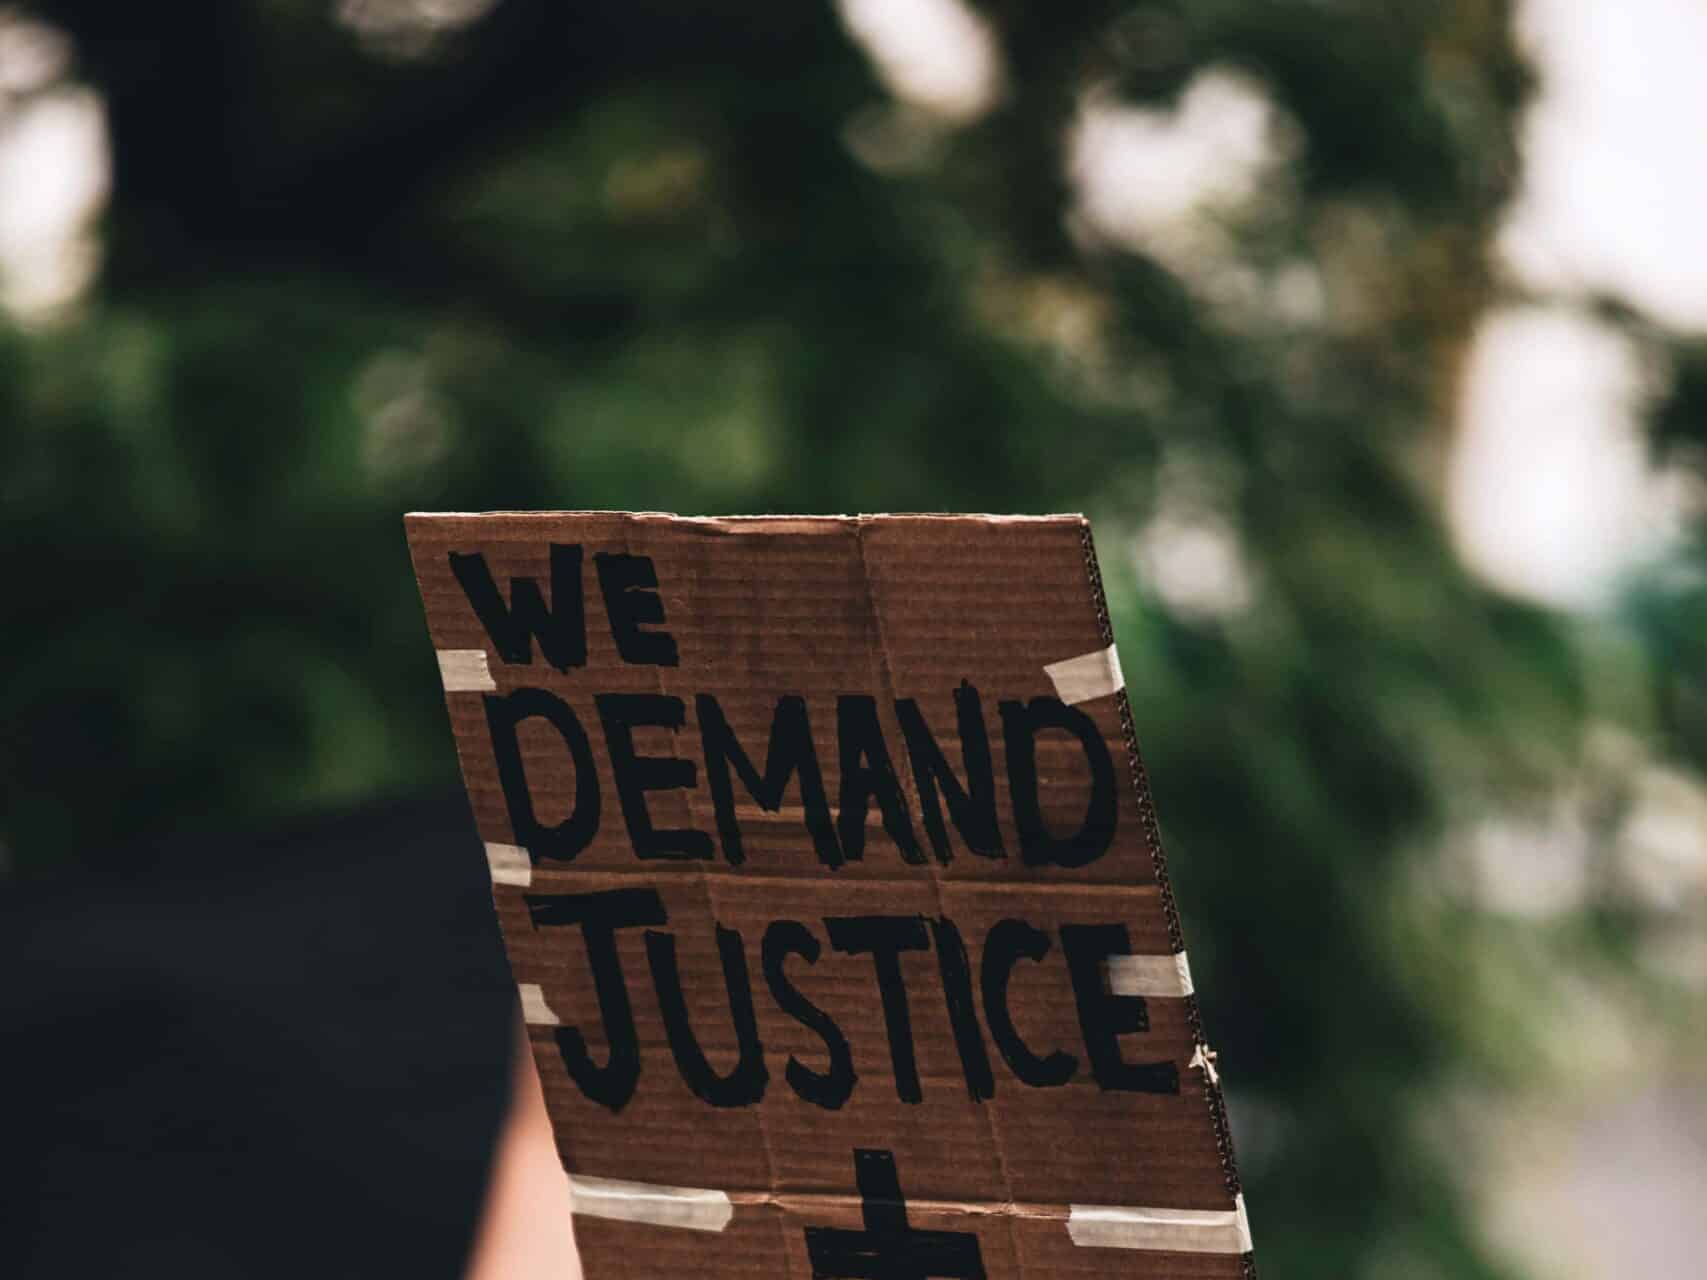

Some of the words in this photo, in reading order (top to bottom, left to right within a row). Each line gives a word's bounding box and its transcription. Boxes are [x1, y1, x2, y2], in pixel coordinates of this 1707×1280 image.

[448, 544, 679, 674] WE
[482, 680, 1117, 871] DEMAND
[523, 888, 1179, 1114] JUSTICE
